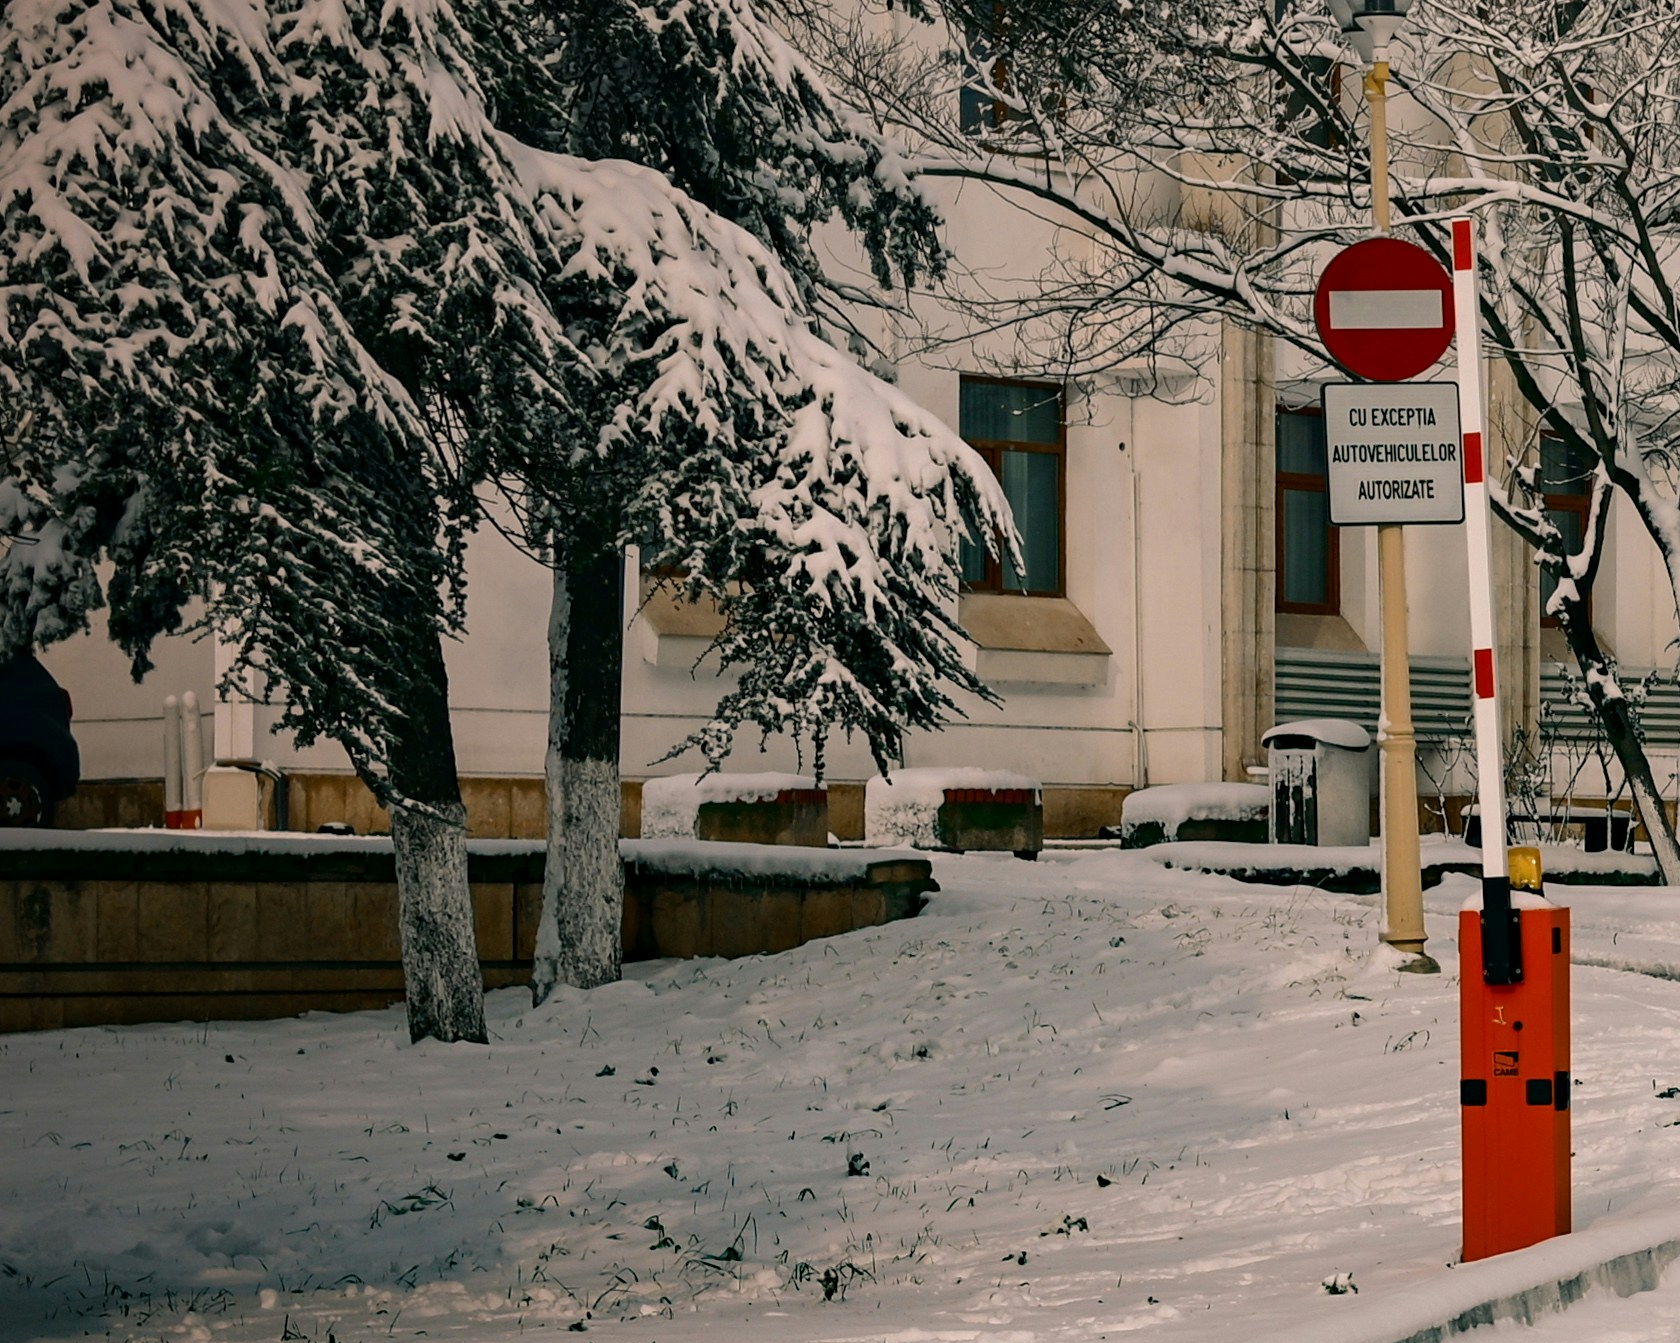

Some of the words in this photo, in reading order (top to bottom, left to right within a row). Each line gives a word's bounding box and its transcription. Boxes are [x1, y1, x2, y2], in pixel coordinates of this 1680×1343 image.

[1349, 408, 1367, 426] CU
[1372, 408, 1436, 429] EXCEPȚIA
[1332, 443, 1456, 463] AUTOVEHICULELOR
[1358, 479, 1435, 500] AUTORIZATE
